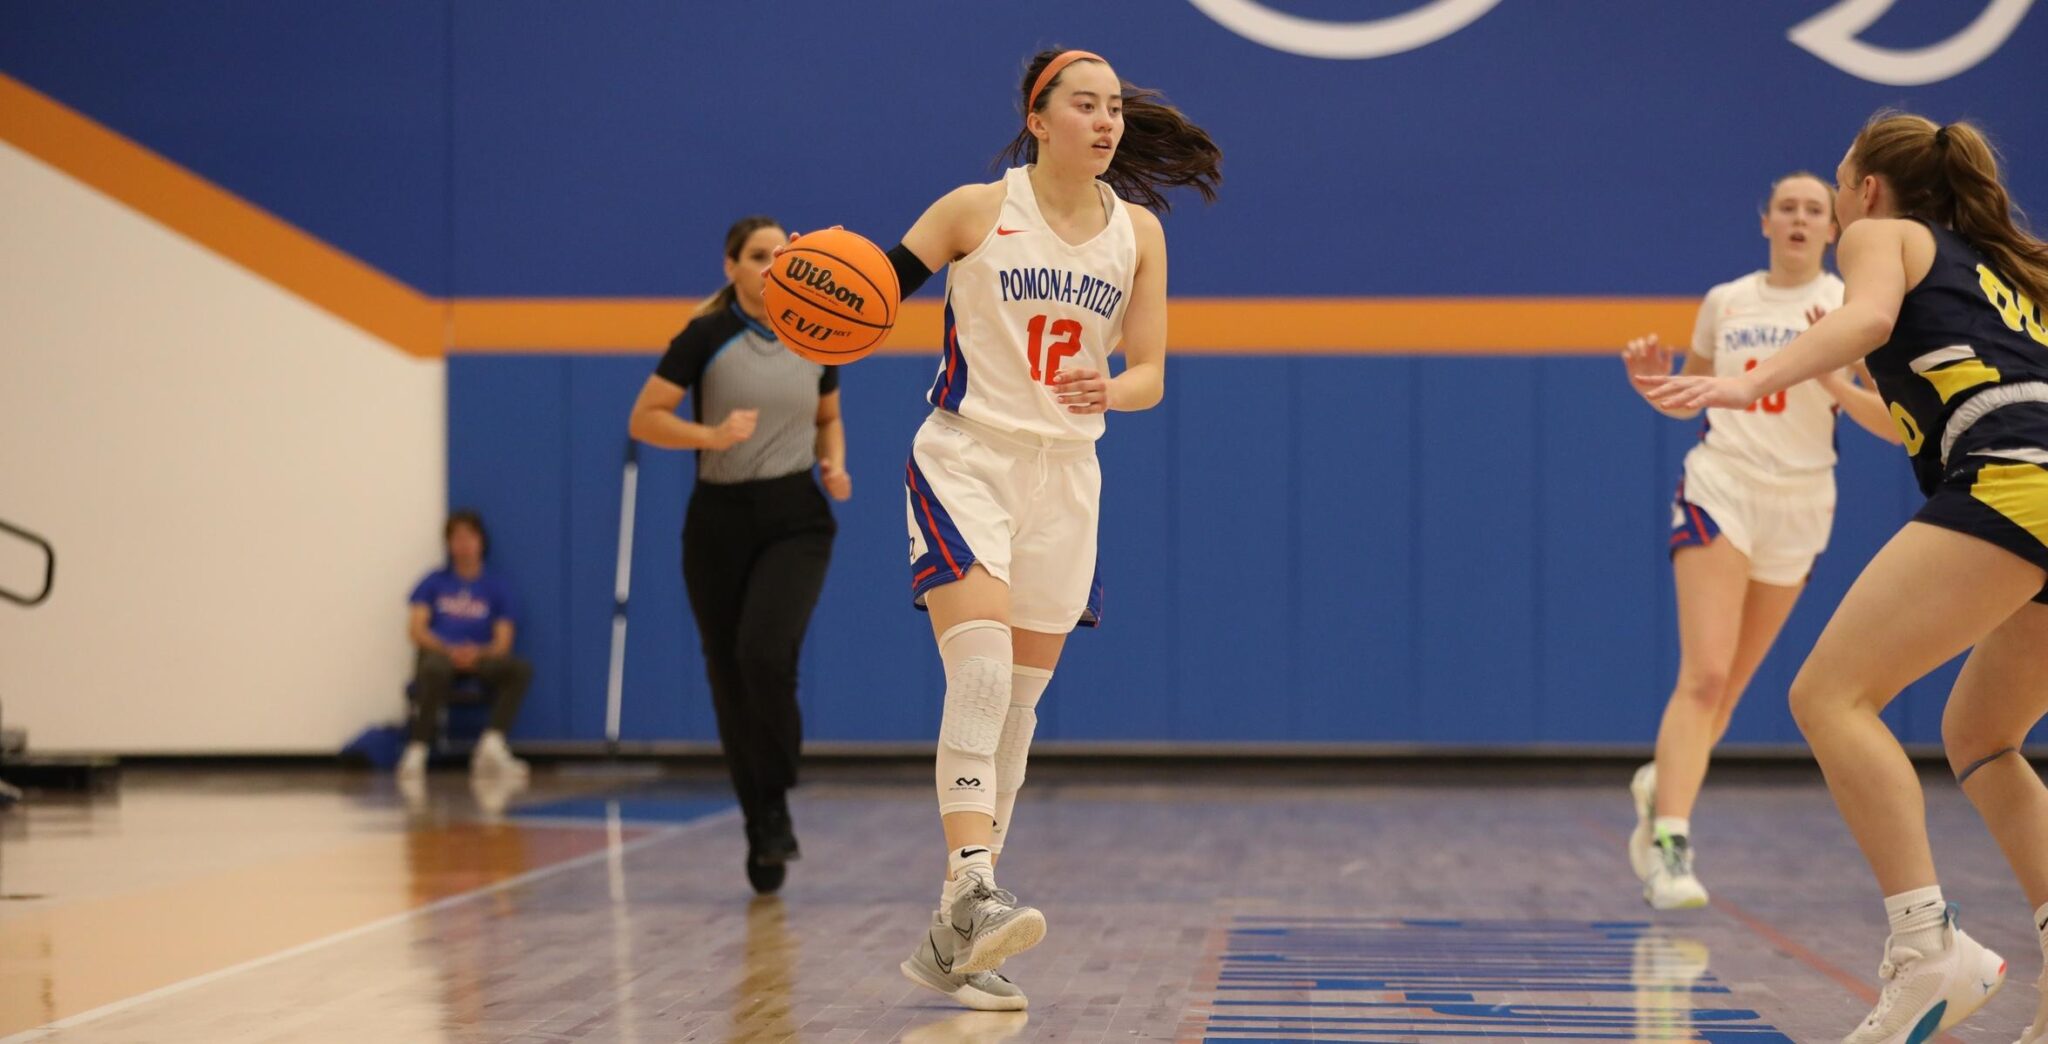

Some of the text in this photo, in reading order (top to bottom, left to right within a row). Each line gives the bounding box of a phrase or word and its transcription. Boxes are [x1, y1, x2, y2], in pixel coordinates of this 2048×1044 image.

[786, 257, 864, 315] Wilson
[999, 267, 1122, 320] POMONA-PITZER
[781, 309, 833, 341] EVO
[1026, 314, 1083, 386] 12
